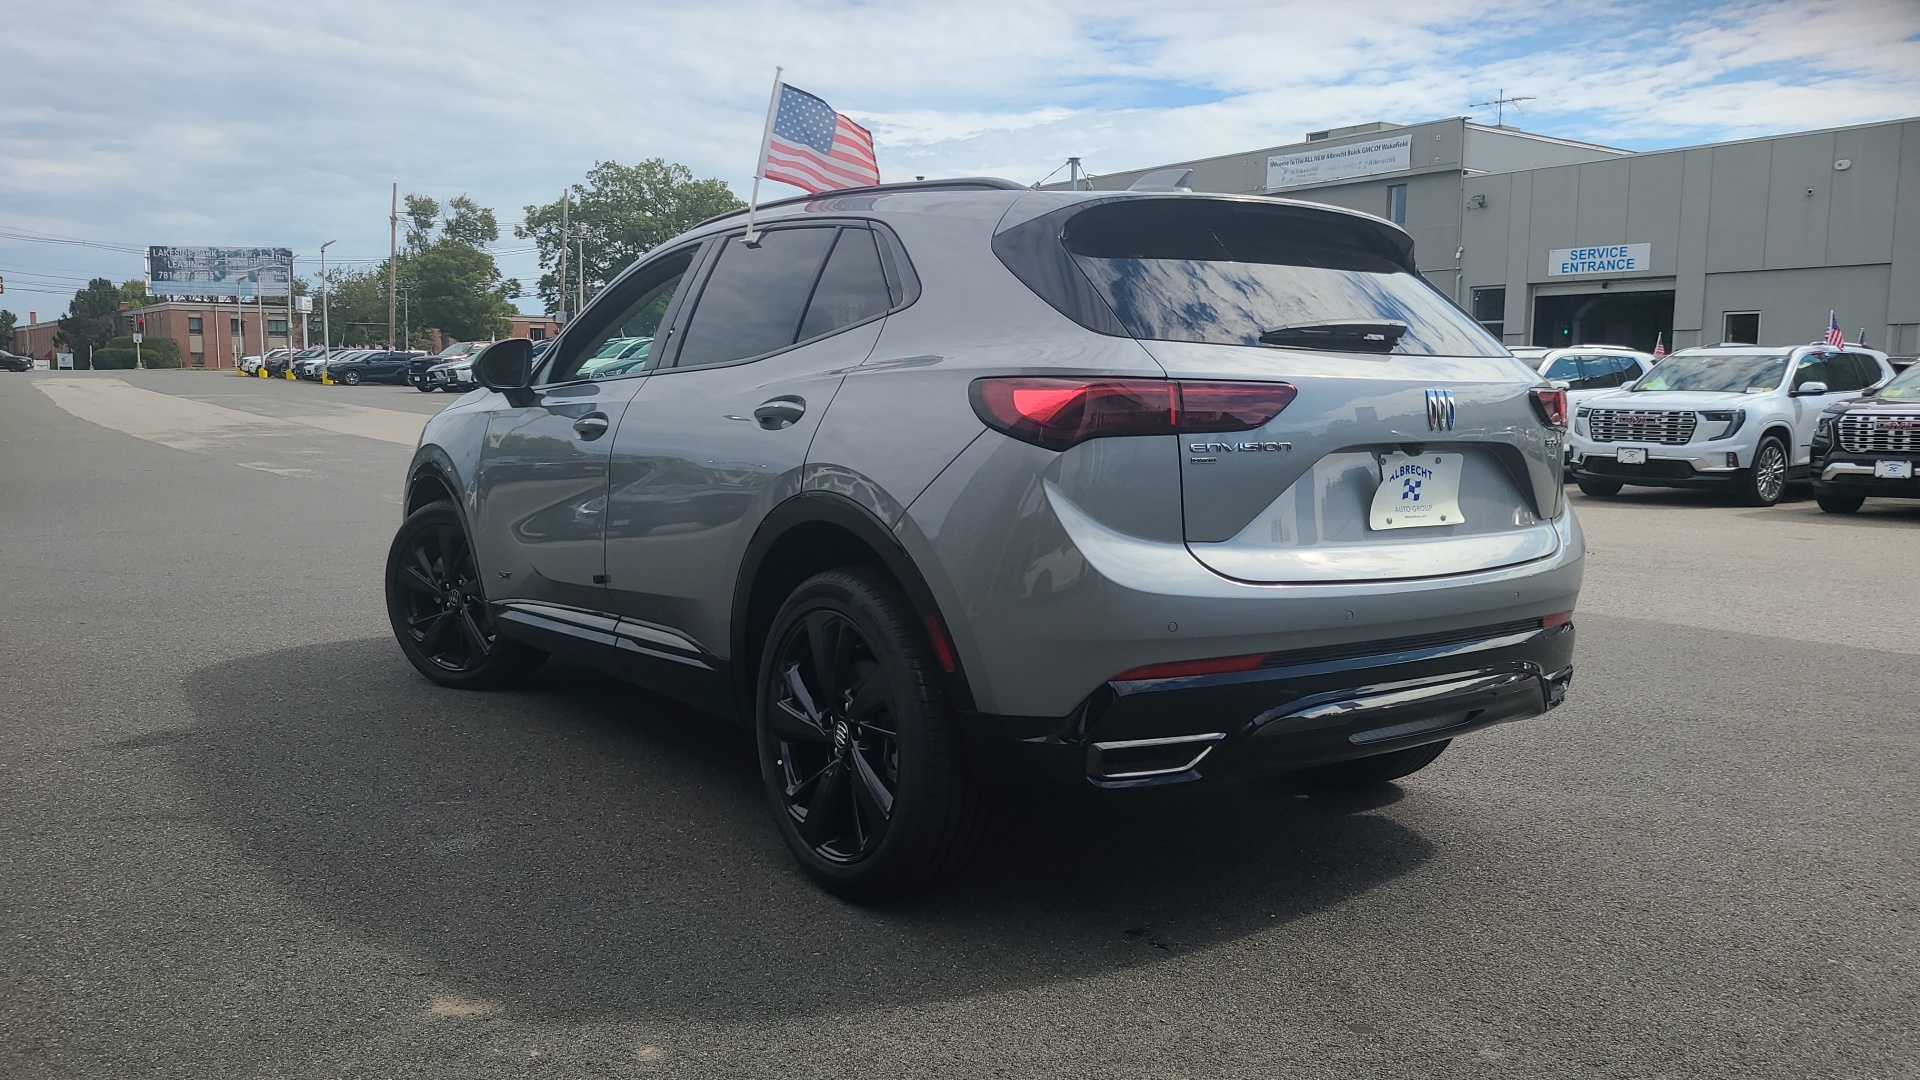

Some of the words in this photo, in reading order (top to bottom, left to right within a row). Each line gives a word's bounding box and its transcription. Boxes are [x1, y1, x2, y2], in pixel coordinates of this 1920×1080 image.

[1326, 151, 1347, 159] Albrecht
[1347, 148, 1361, 157] Buick
[1362, 146, 1374, 154] GMC
[1382, 140, 1409, 150] Wakefield
[1368, 156, 1396, 166] Albrecht
[153, 248, 192, 257] LAKESIDE
[196, 249, 218, 257] PARK
[1570, 246, 1628, 260] SERVICE
[167, 260, 204, 268] LEASING
[1561, 258, 1635, 273] ENTRANCE
[1190, 442, 1292, 453] ENVISION
[1389, 465, 1432, 482] ALBRECHT
[1412, 504, 1433, 512] GROUP
